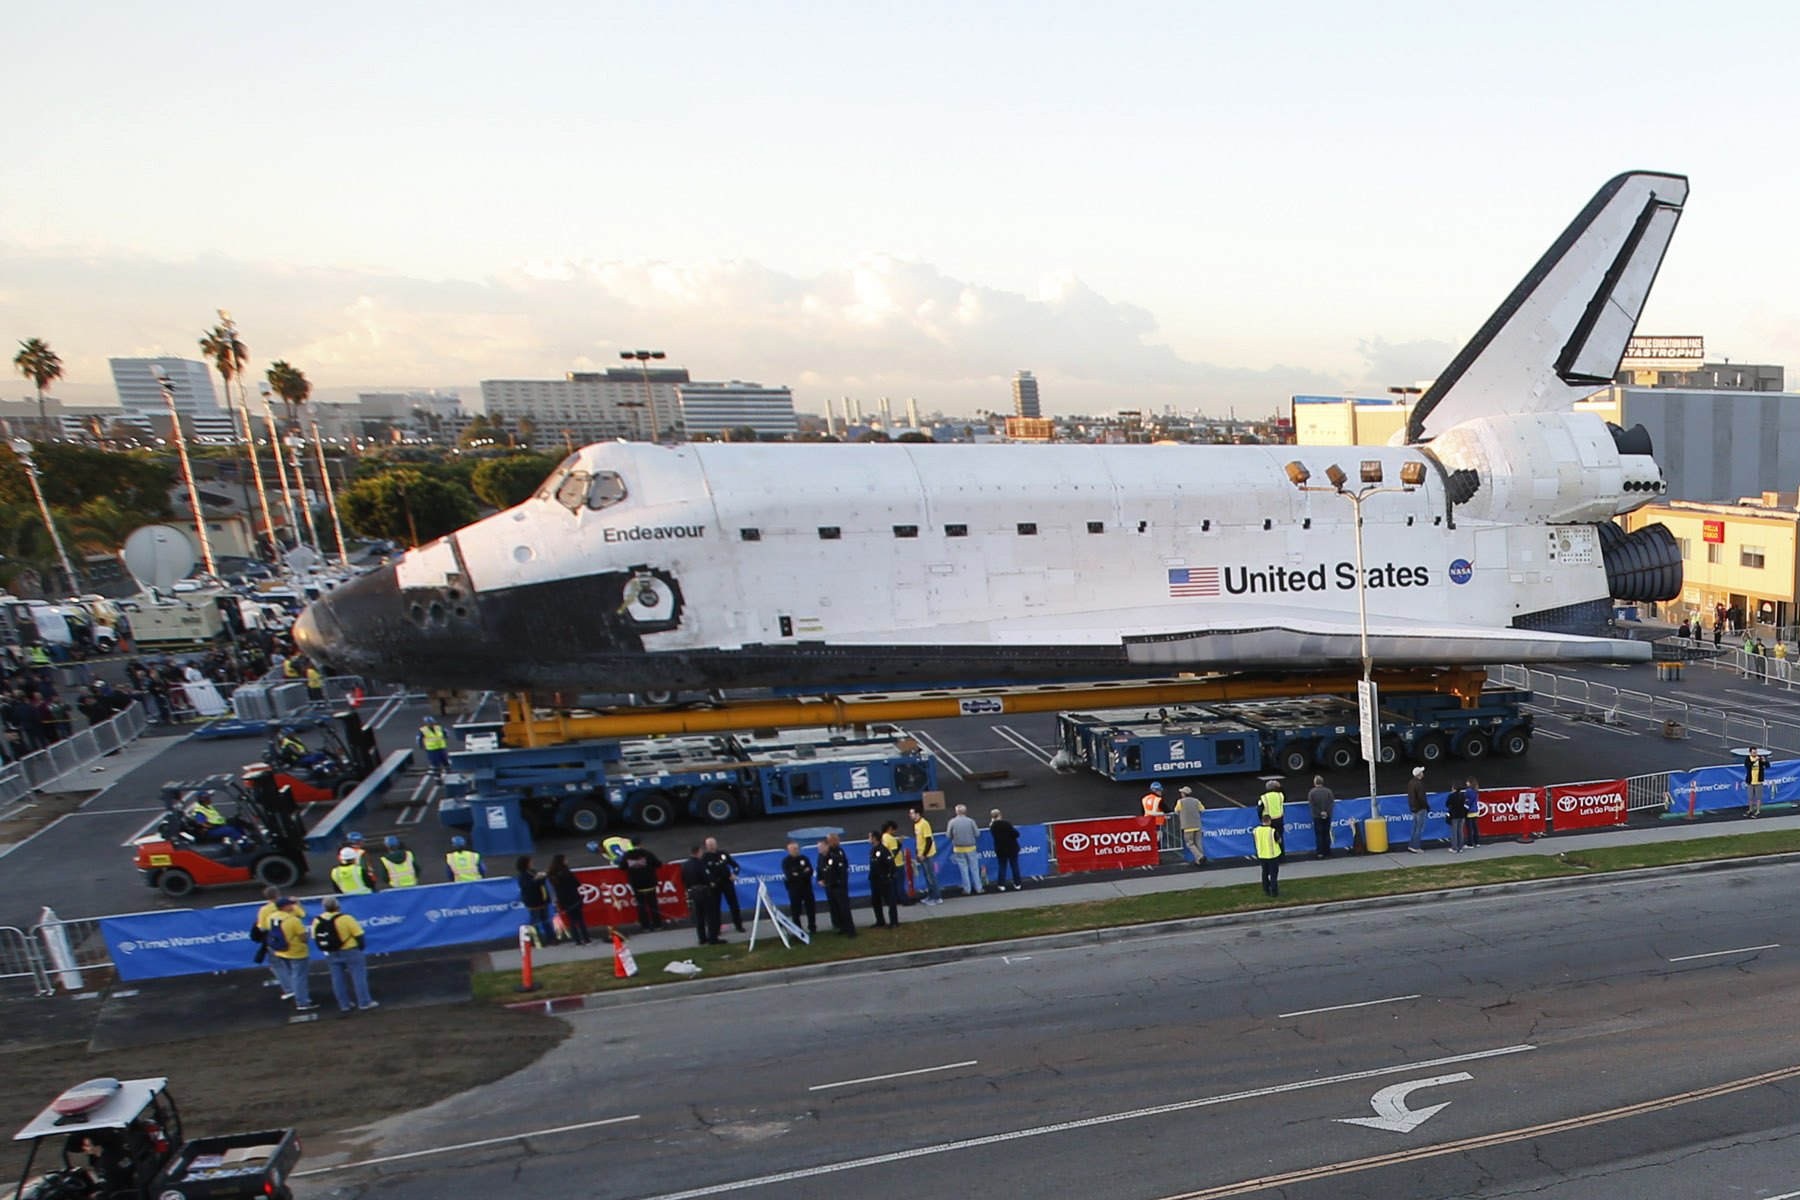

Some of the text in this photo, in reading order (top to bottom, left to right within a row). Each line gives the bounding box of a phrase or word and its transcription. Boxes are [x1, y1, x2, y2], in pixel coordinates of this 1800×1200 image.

[603, 525, 705, 542] Endeavour
[1450, 567, 1472, 576] NASA
[1224, 562, 1430, 595] United States
[1154, 760, 1202, 772] sarens
[1714, 783, 1729, 791] Cable
[833, 787, 891, 800] sarens
[1579, 793, 1623, 807] TOYOTA
[1489, 801, 1541, 814] TOYA
[1580, 807, 1594, 816] Let's
[1595, 806, 1603, 814] Go
[1492, 814, 1507, 822] Let's
[1218, 827, 1246, 837] Warner
[1294, 822, 1311, 830] Time
[1090, 831, 1151, 846] TOYOTA
[1020, 845, 1039, 854] able
[1095, 844, 1152, 856] Let's Go Places
[758, 873, 785, 882] Warn
[440, 908, 468, 918] Time
[468, 902, 509, 914] Warner
[135, 939, 168, 950] Time
[168, 934, 217, 948] Warner
